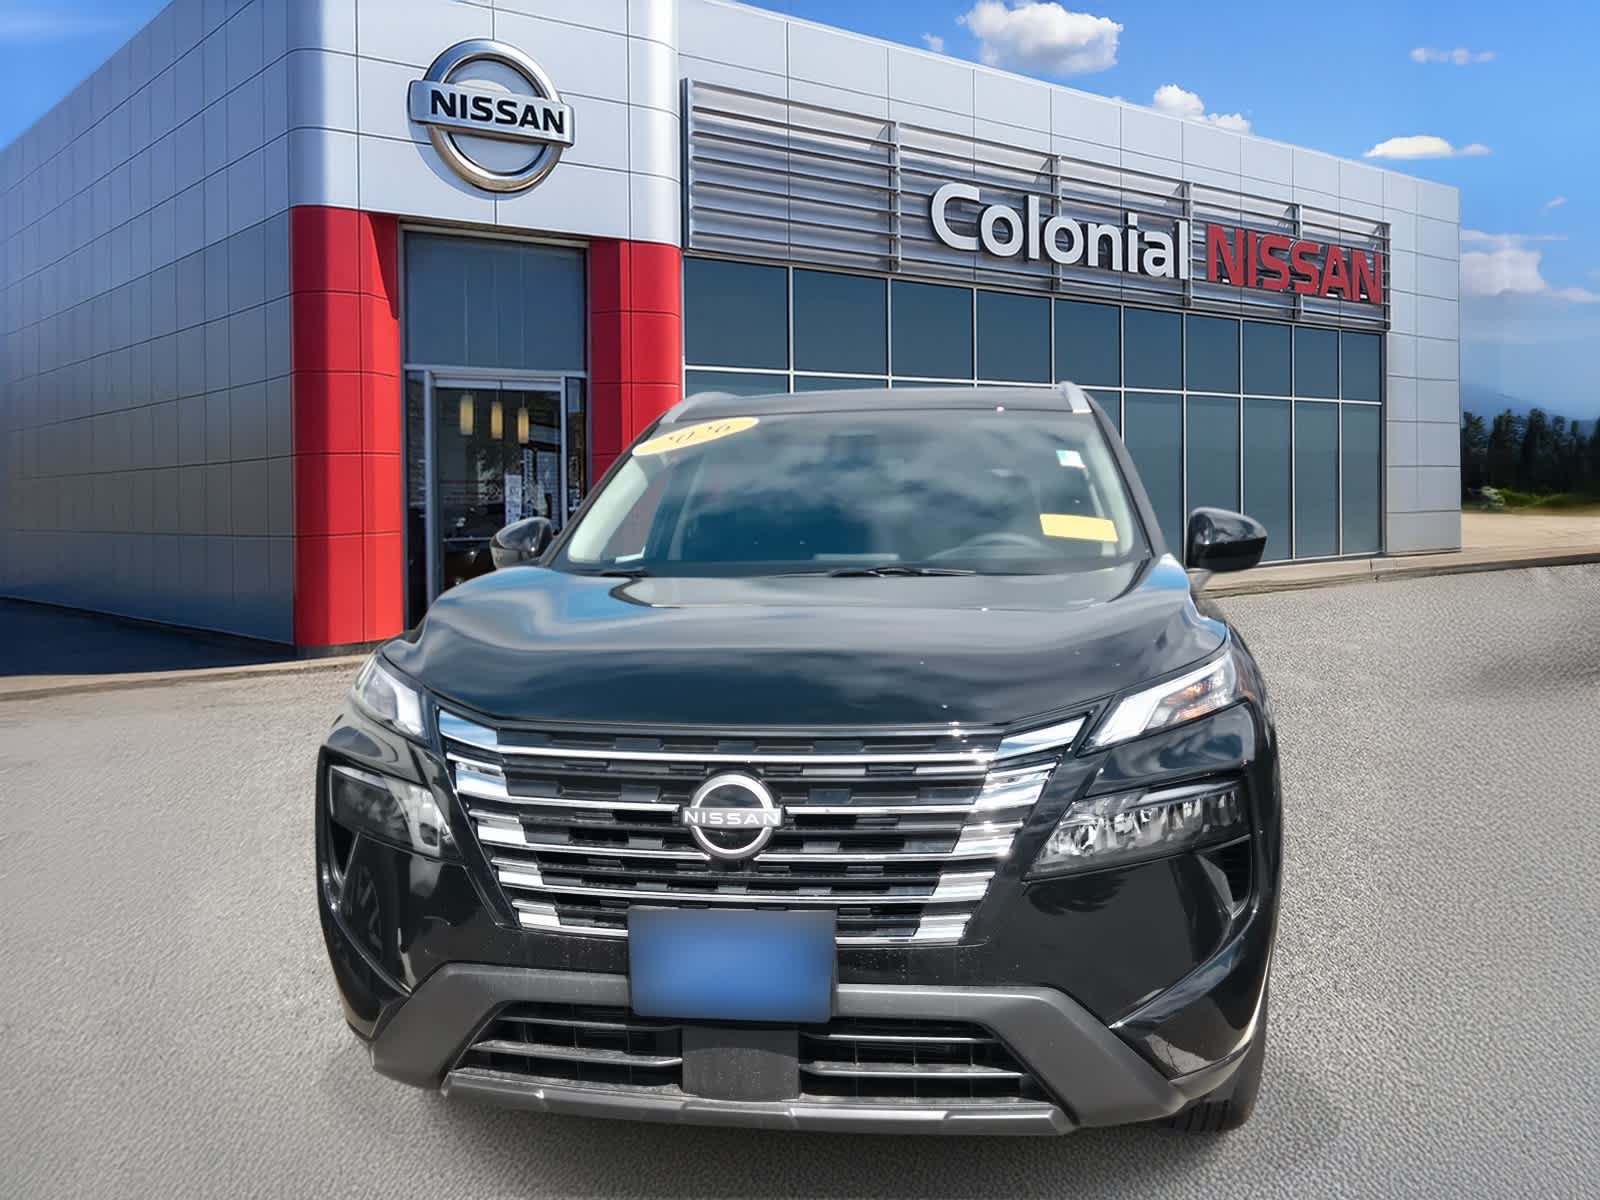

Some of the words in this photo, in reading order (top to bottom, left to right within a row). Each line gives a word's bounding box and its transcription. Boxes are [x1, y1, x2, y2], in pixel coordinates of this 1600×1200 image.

[431, 90, 564, 134] NISSAN
[931, 182, 1189, 280] Colonial
[1207, 224, 1383, 305] NISSAN
[684, 811, 779, 825] NISSAN
